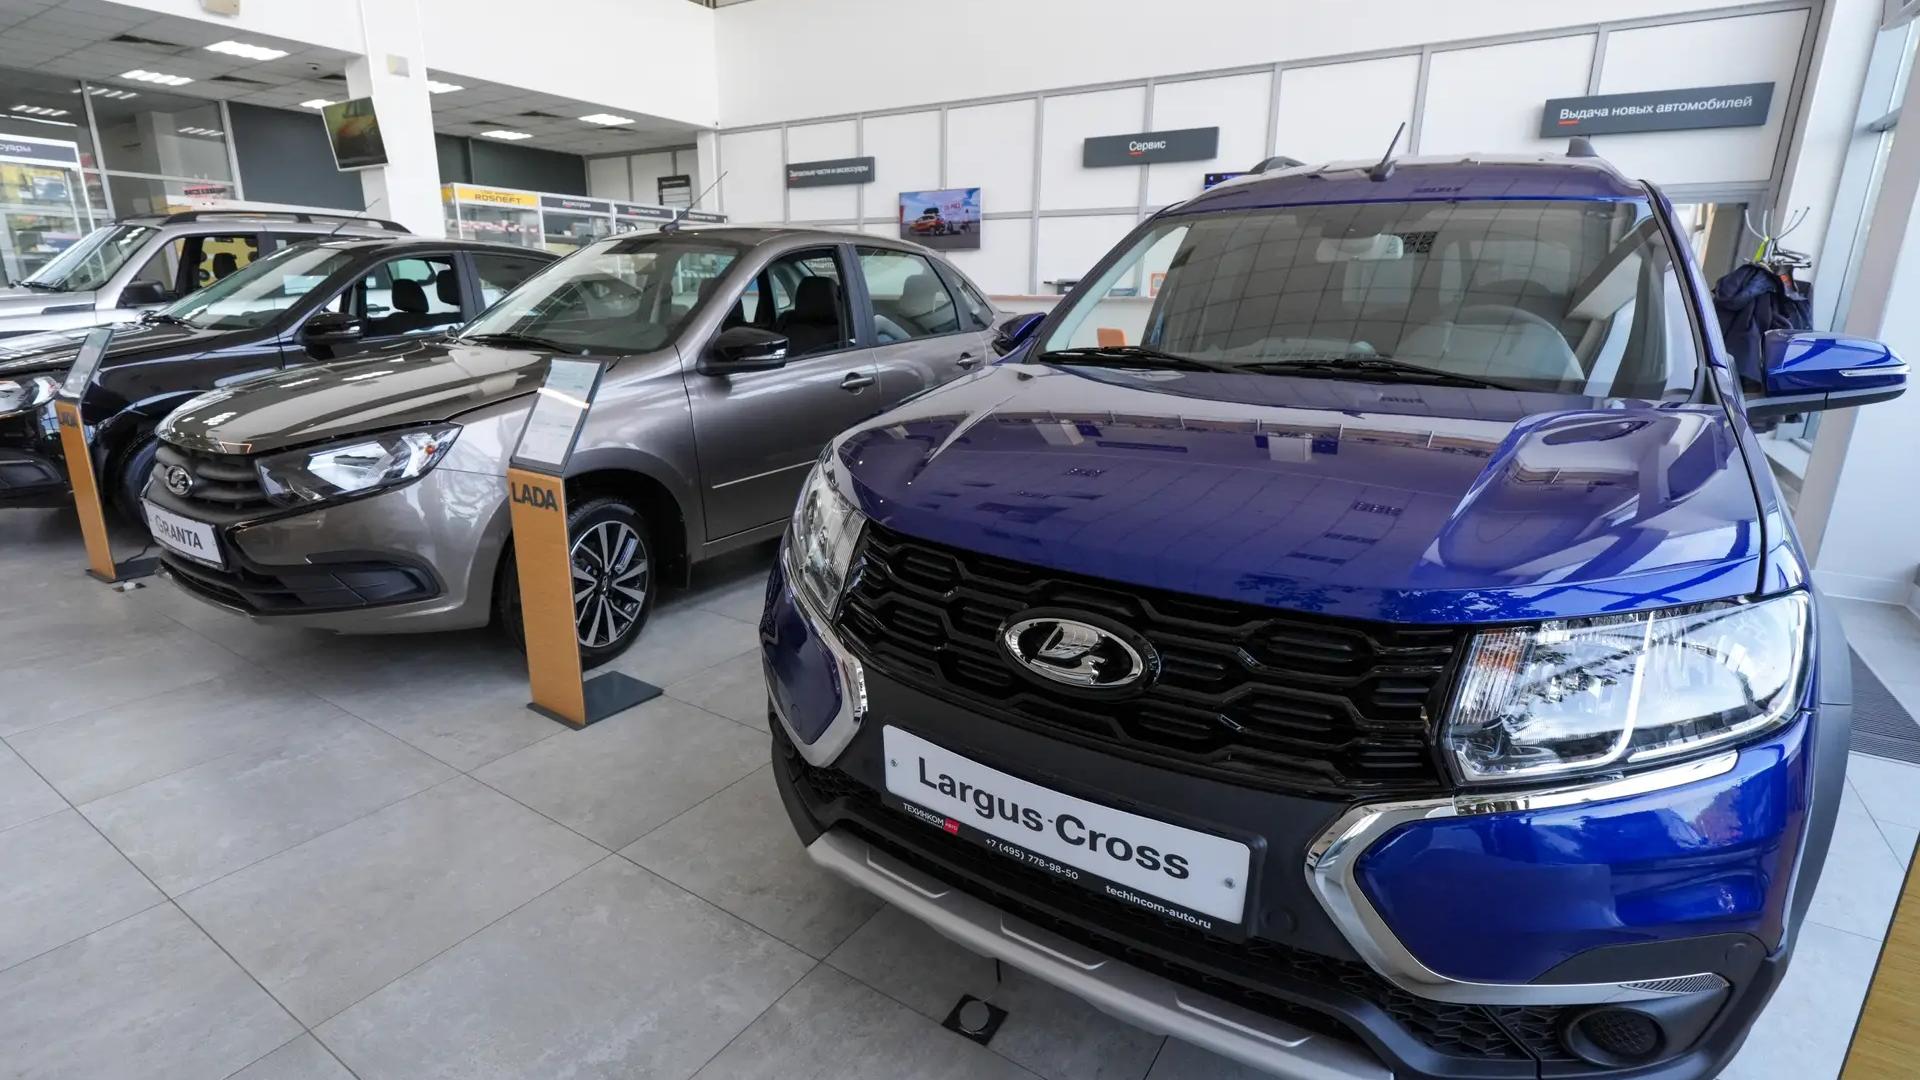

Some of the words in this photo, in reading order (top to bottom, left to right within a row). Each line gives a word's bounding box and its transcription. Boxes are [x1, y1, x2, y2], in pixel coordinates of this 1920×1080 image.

[1559, 105, 1608, 121] Выдача
[1612, 104, 1654, 117] новых
[1656, 96, 1753, 113] автомобилей
[1129, 140, 1166, 152] Сервис
[511, 482, 558, 512] LADA
[155, 514, 204, 551] GRANTA
[903, 802, 944, 826] ТЕХИНКОМ
[918, 756, 1043, 832] Largus
[1055, 813, 1190, 880] Cross
[985, 837, 997, 848] +7
[999, 842, 1025, 860] (495)
[1027, 854, 1079, 880] 778-98-50
[1105, 884, 1212, 930] techincom-auto.ru
